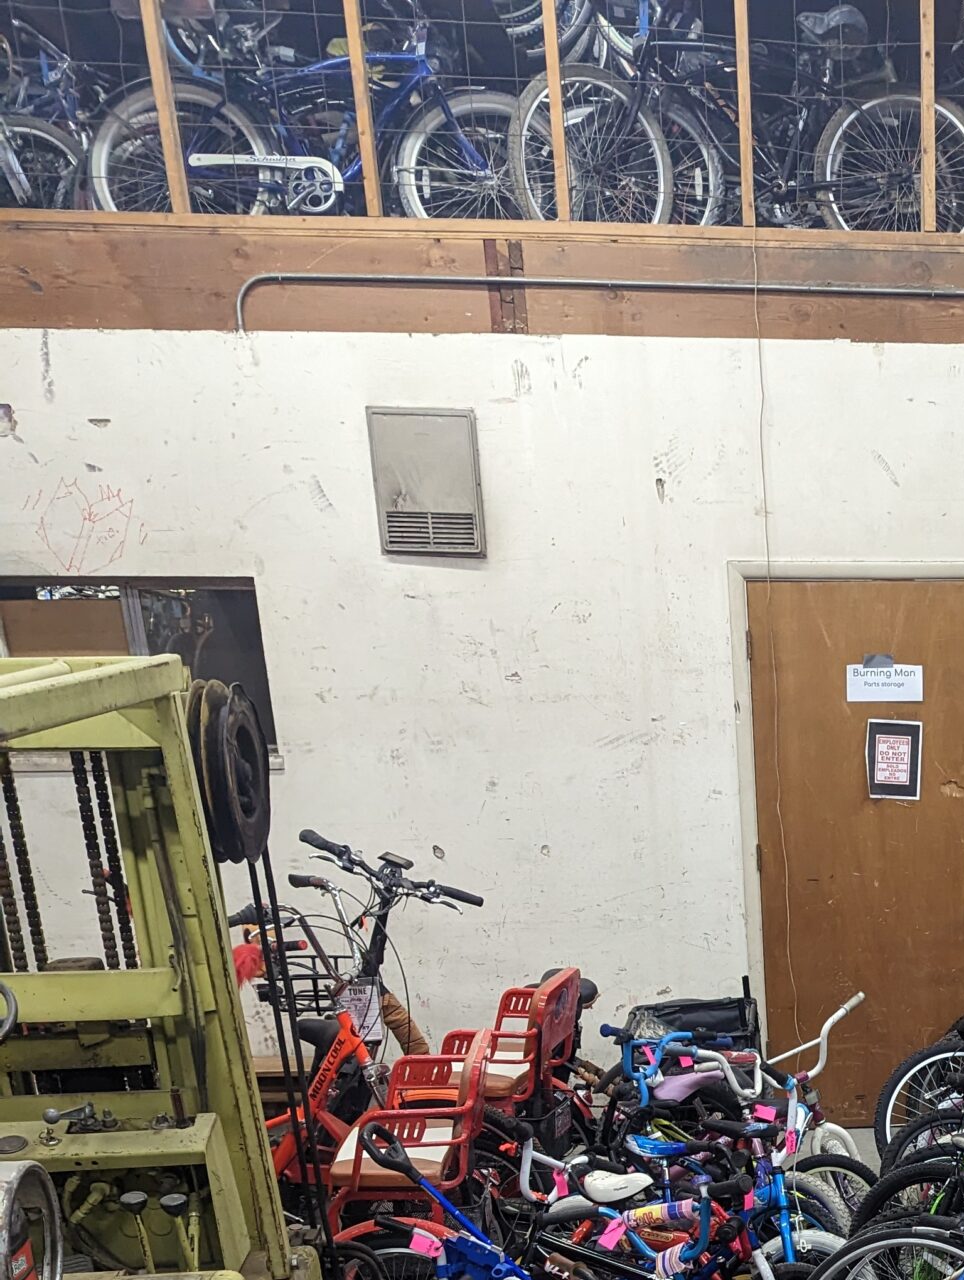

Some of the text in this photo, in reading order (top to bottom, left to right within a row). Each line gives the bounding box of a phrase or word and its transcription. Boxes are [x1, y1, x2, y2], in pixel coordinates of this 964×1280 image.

[852, 667, 916, 679] Burning Man
[881, 681, 905, 689] storage
[348, 987, 367, 996] TUNE
[309, 1038, 346, 1102] MOONCOOL
